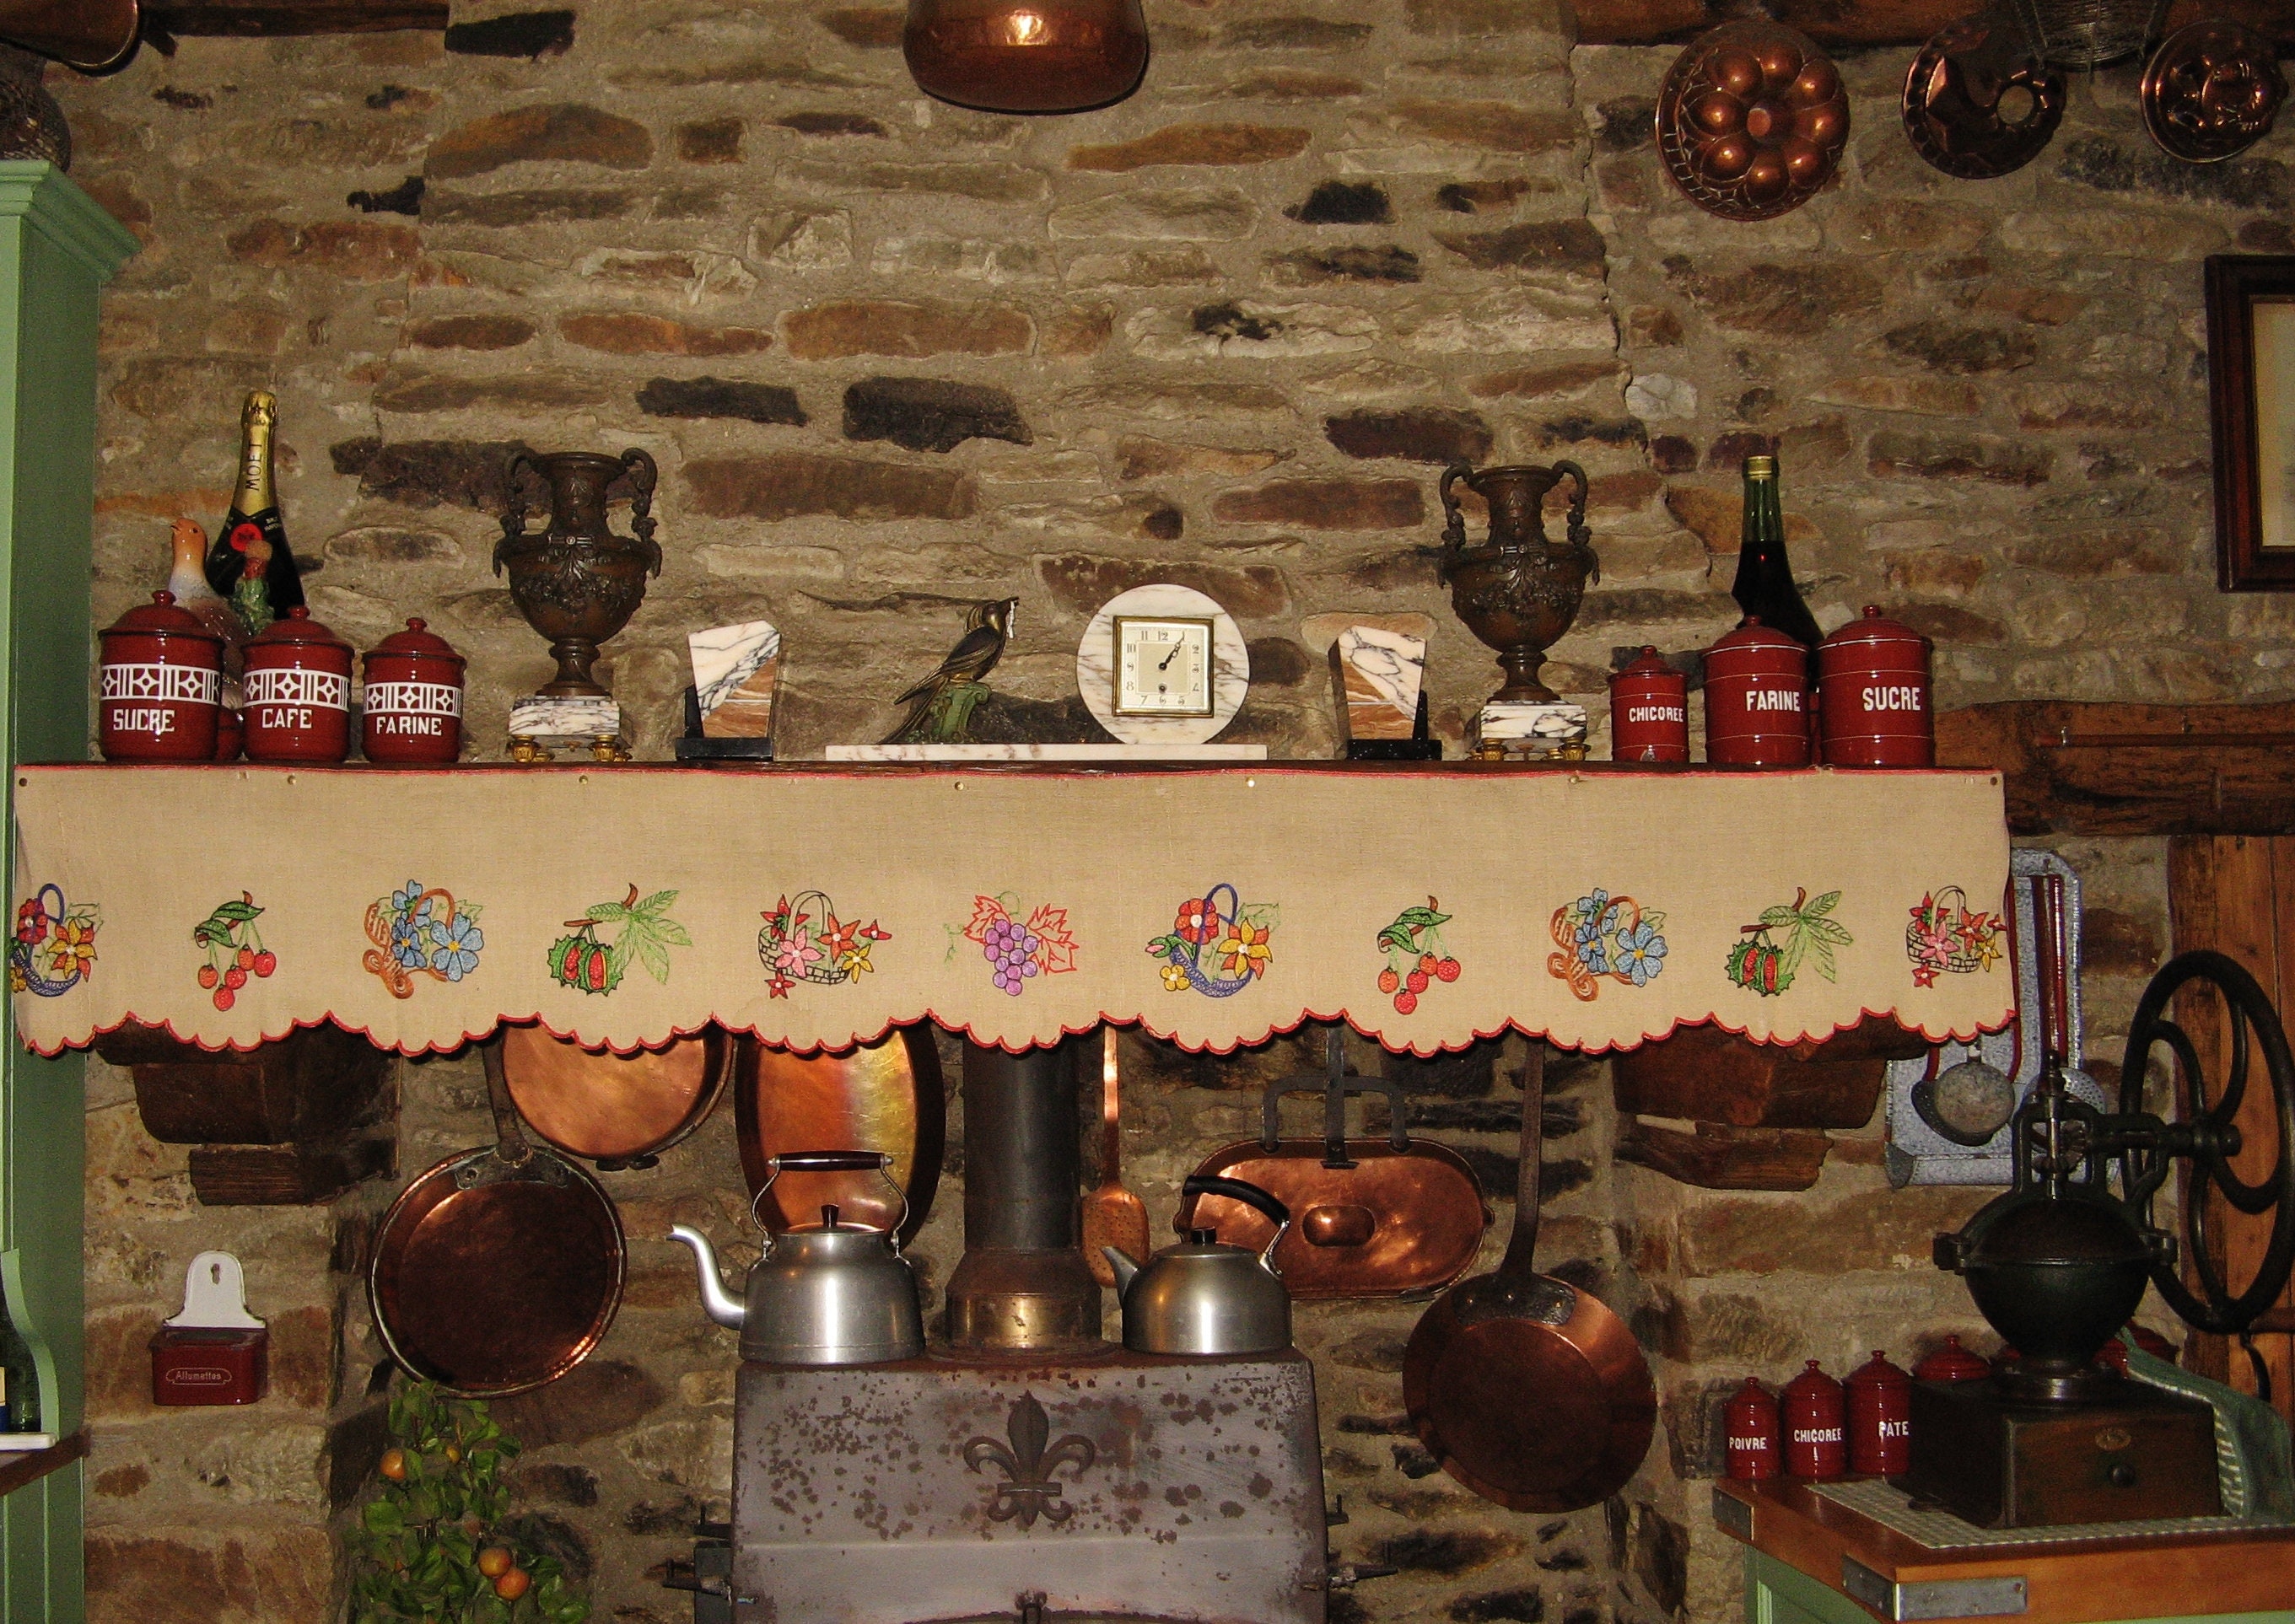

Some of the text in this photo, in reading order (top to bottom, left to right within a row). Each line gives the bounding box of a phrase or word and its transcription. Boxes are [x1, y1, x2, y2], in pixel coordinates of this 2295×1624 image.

[1158, 631, 1168, 641] 12
[1127, 643, 1136, 653] 10
[1192, 644, 1199, 654] 2
[1126, 680, 1134, 691] 8
[1746, 690, 1802, 713] FARINE
[1862, 687, 1921, 712] SUCRE
[113, 708, 175, 733] SUCRE
[261, 708, 313, 729] CAFE
[1629, 707, 1684, 723] CHICOREE
[376, 716, 443, 736] FARINE
[1793, 1428, 1841, 1443] CHICOREE
[1729, 1437, 1767, 1450] POIVRE
